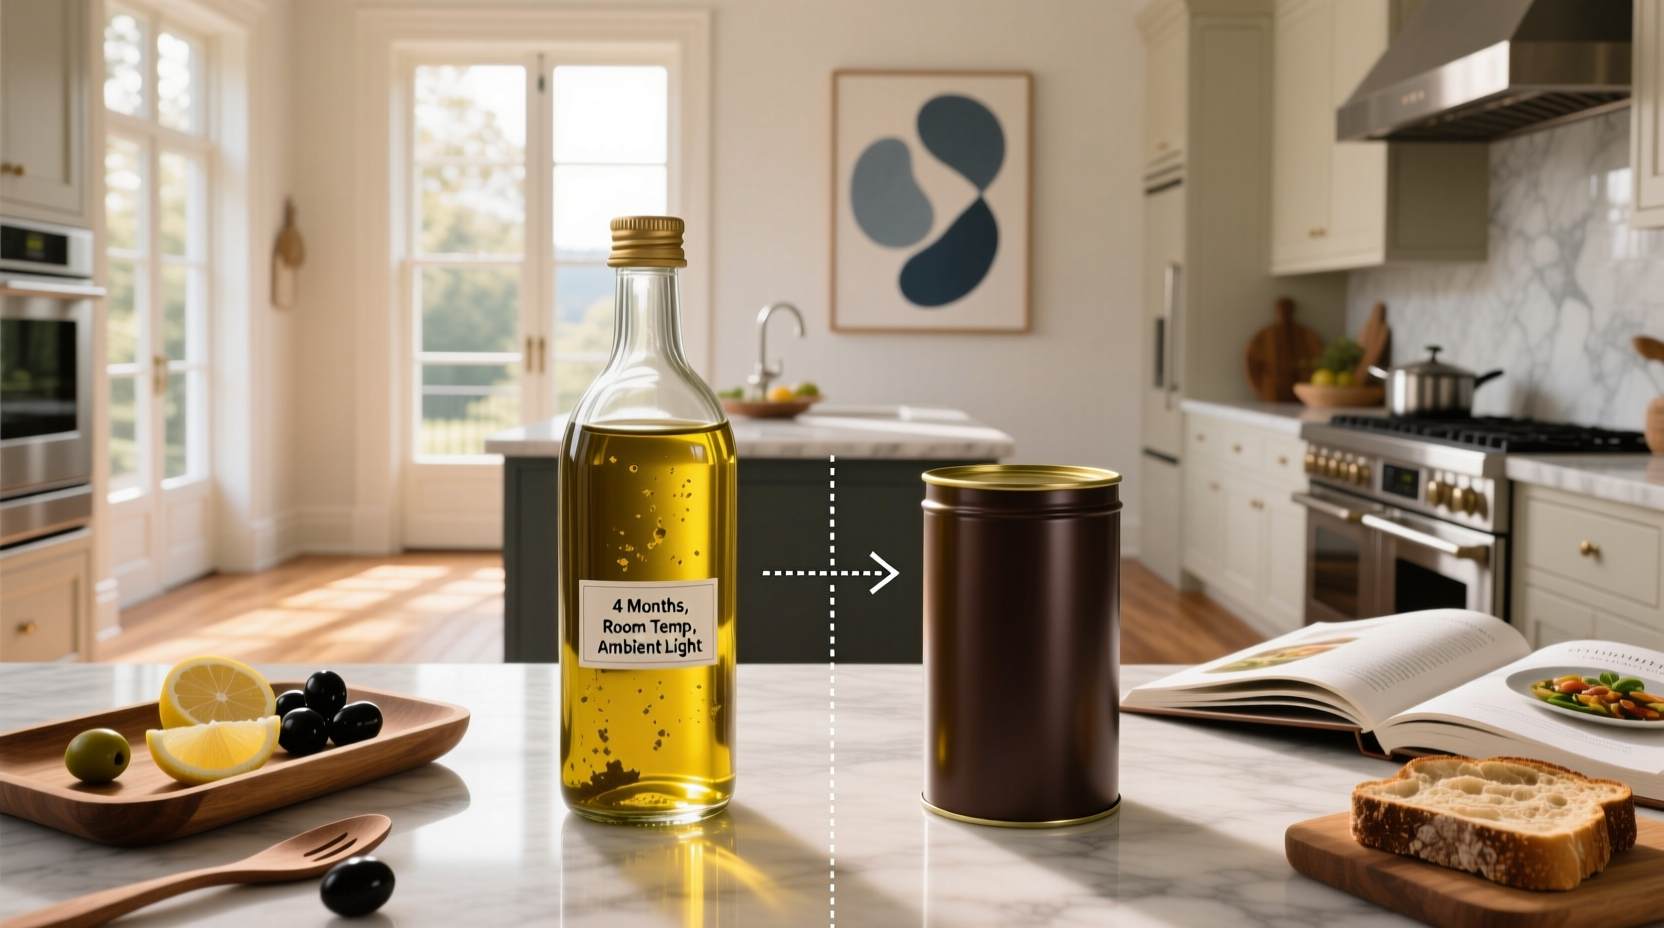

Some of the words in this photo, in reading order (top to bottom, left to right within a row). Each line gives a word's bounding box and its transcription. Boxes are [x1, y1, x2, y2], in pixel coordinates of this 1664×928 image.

[612, 598, 623, 613] 4
[627, 597, 689, 615] Months,
[603, 619, 646, 634] Room
[650, 619, 697, 638] Temp,
[598, 638, 662, 654] Ambient
[665, 638, 703, 657] Light
